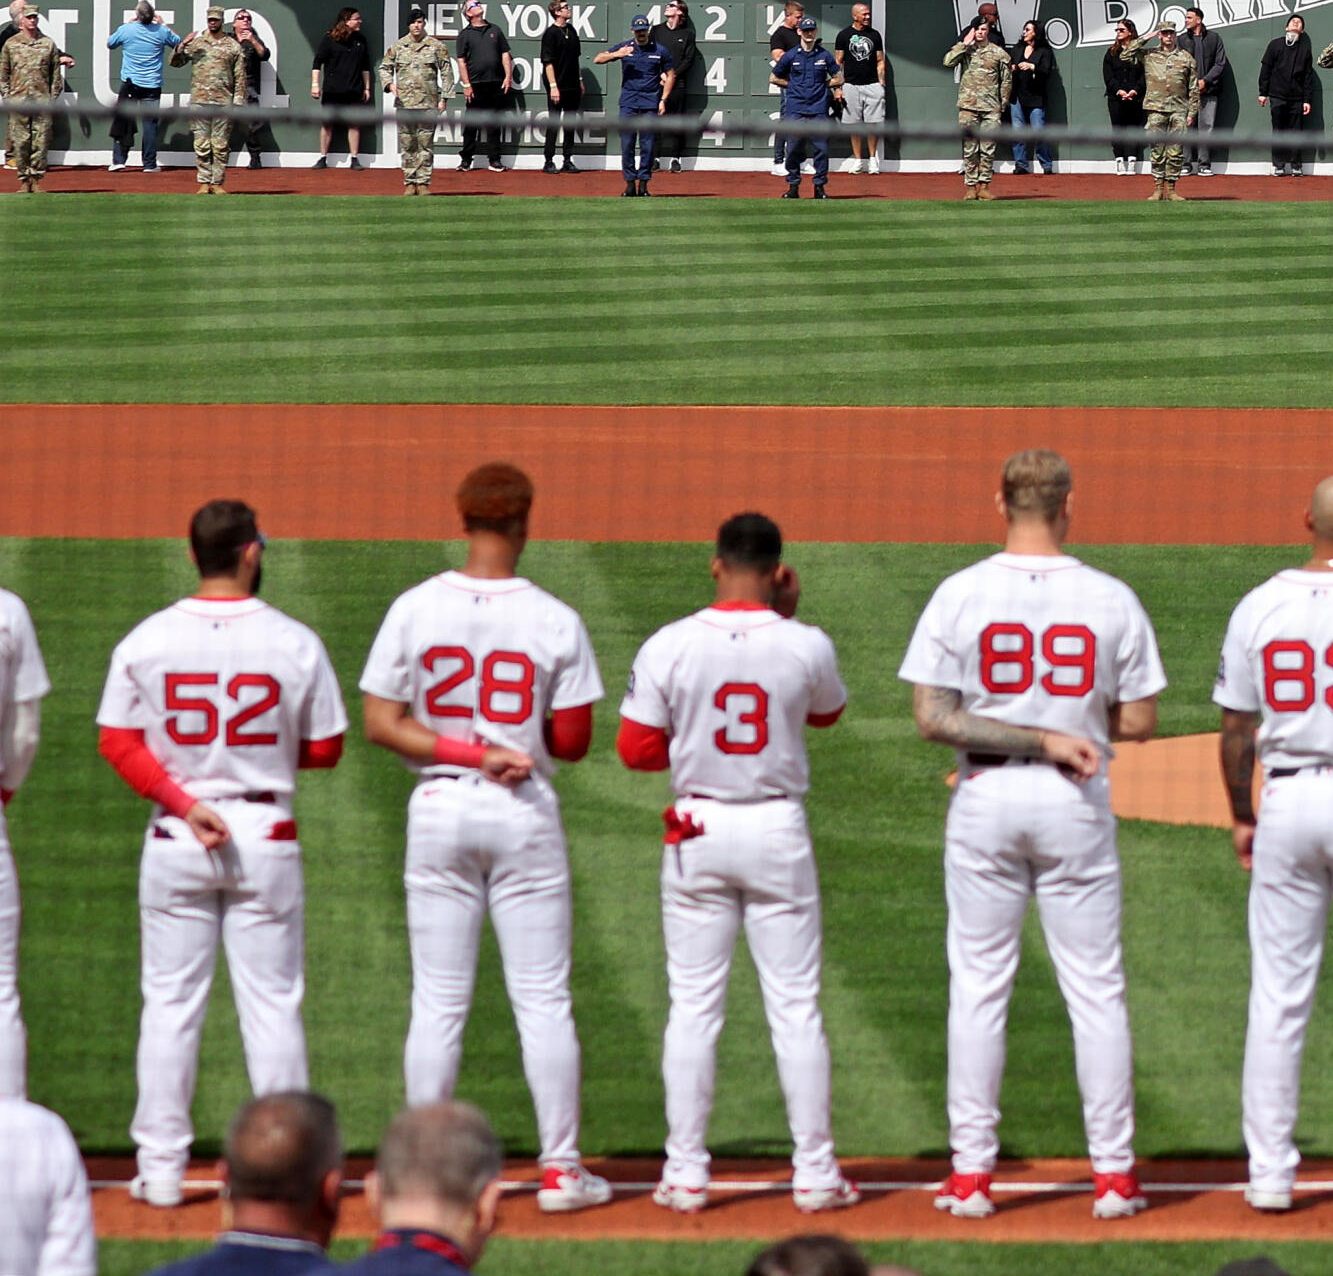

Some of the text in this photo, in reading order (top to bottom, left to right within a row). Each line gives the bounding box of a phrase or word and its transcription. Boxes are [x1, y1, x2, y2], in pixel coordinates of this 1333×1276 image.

[501, 4, 595, 38] YOK
[705, 6, 727, 40] 2
[705, 58, 727, 93] 4
[422, 647, 535, 724] 28
[980, 622, 1096, 697] 89
[165, 673, 280, 746] 52
[714, 682, 769, 755] 3
